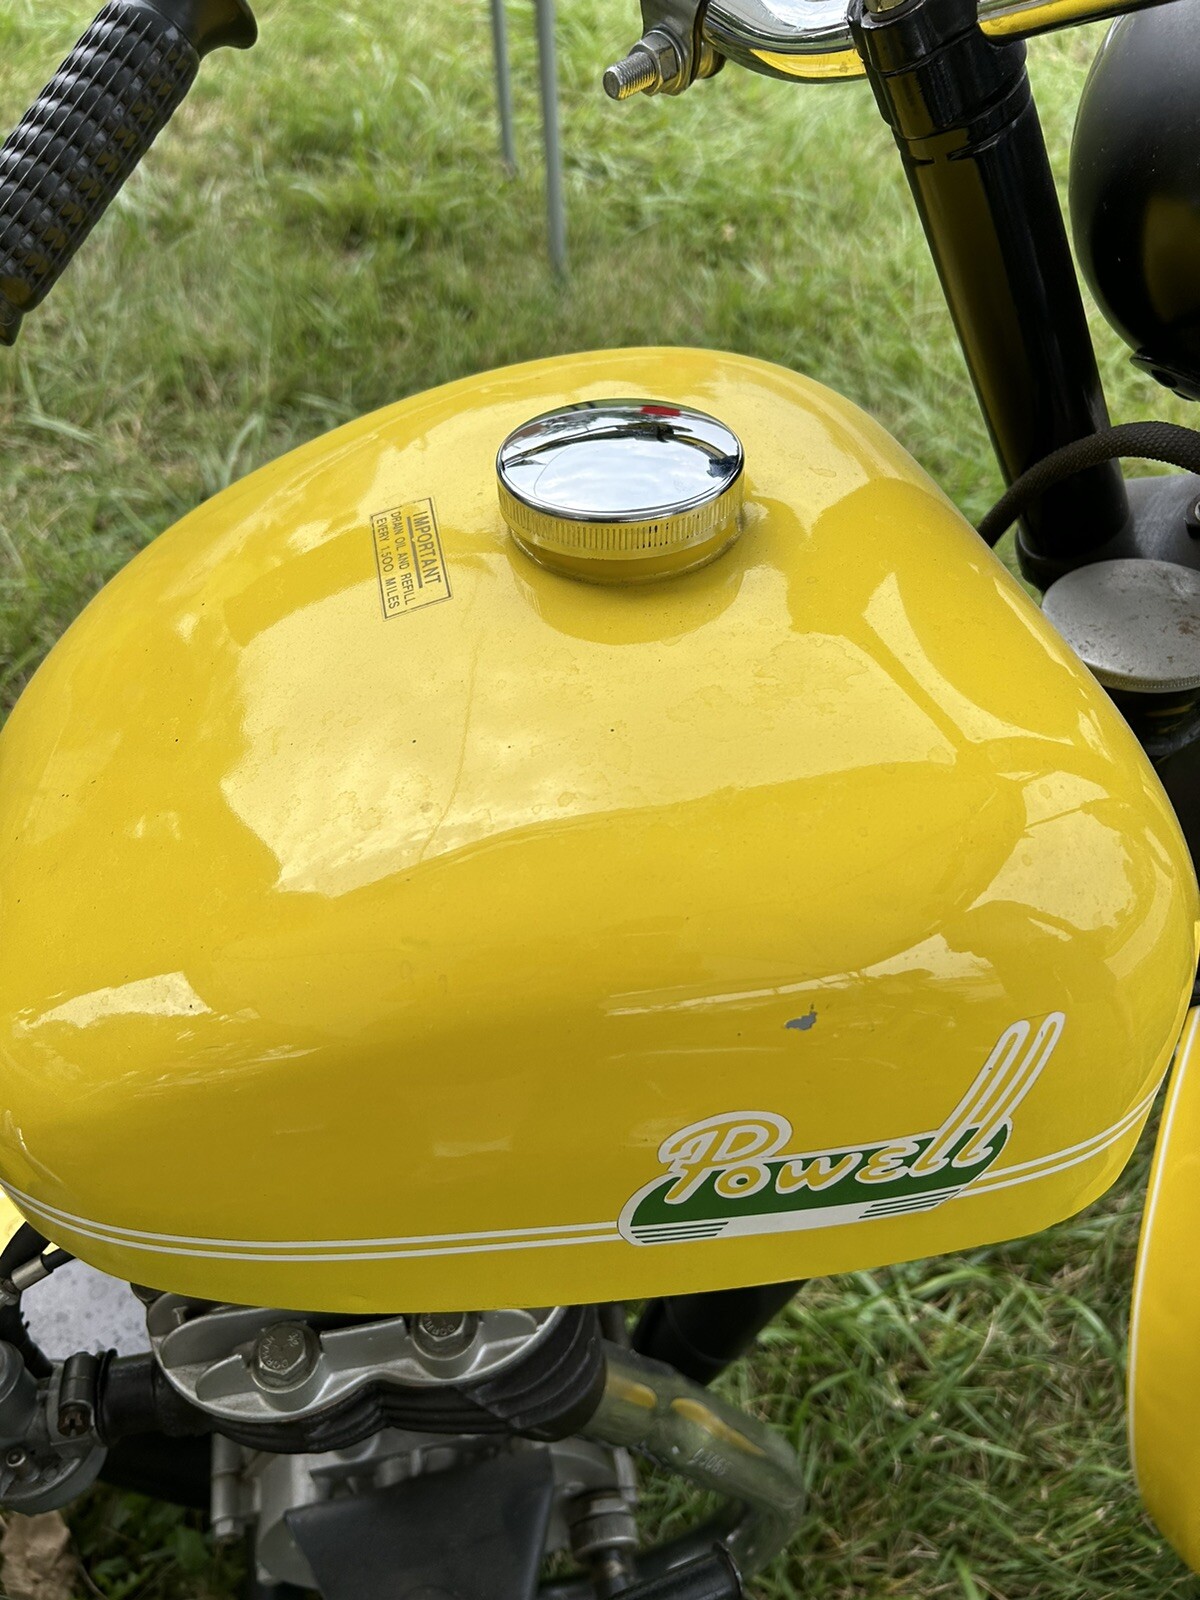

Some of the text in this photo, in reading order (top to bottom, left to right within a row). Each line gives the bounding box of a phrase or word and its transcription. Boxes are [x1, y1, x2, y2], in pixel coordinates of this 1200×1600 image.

[376, 518, 389, 542] EVERY
[385, 577, 400, 610] MILES
[391, 511, 416, 606] DRAIN OIL AND REFILL
[413, 510, 441, 584] IMPORTANT
